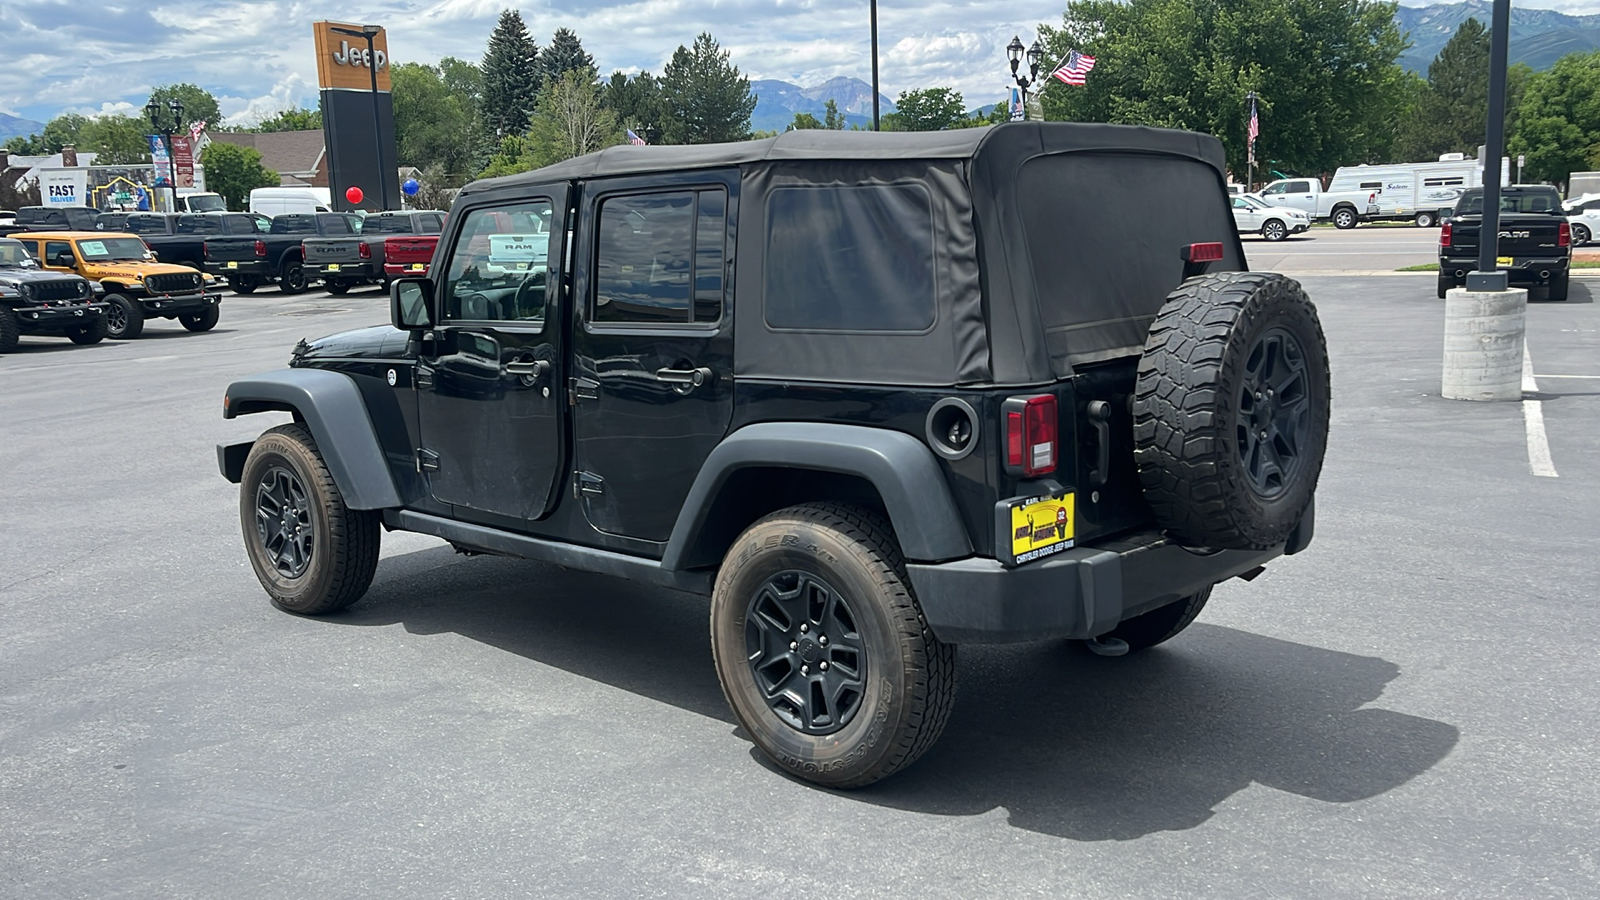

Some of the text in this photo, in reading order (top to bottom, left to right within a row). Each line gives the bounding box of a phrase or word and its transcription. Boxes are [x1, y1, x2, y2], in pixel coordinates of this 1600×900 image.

[333, 40, 387, 73] Jeep
[49, 185, 75, 196] FAST
[97, 270, 134, 278] RUBICON
[1057, 510, 1066, 520] 32
[1016, 539, 1074, 564] CHRYSLER DODGE JEEP RAM
[776, 676, 893, 773] BRIDGESTONE
